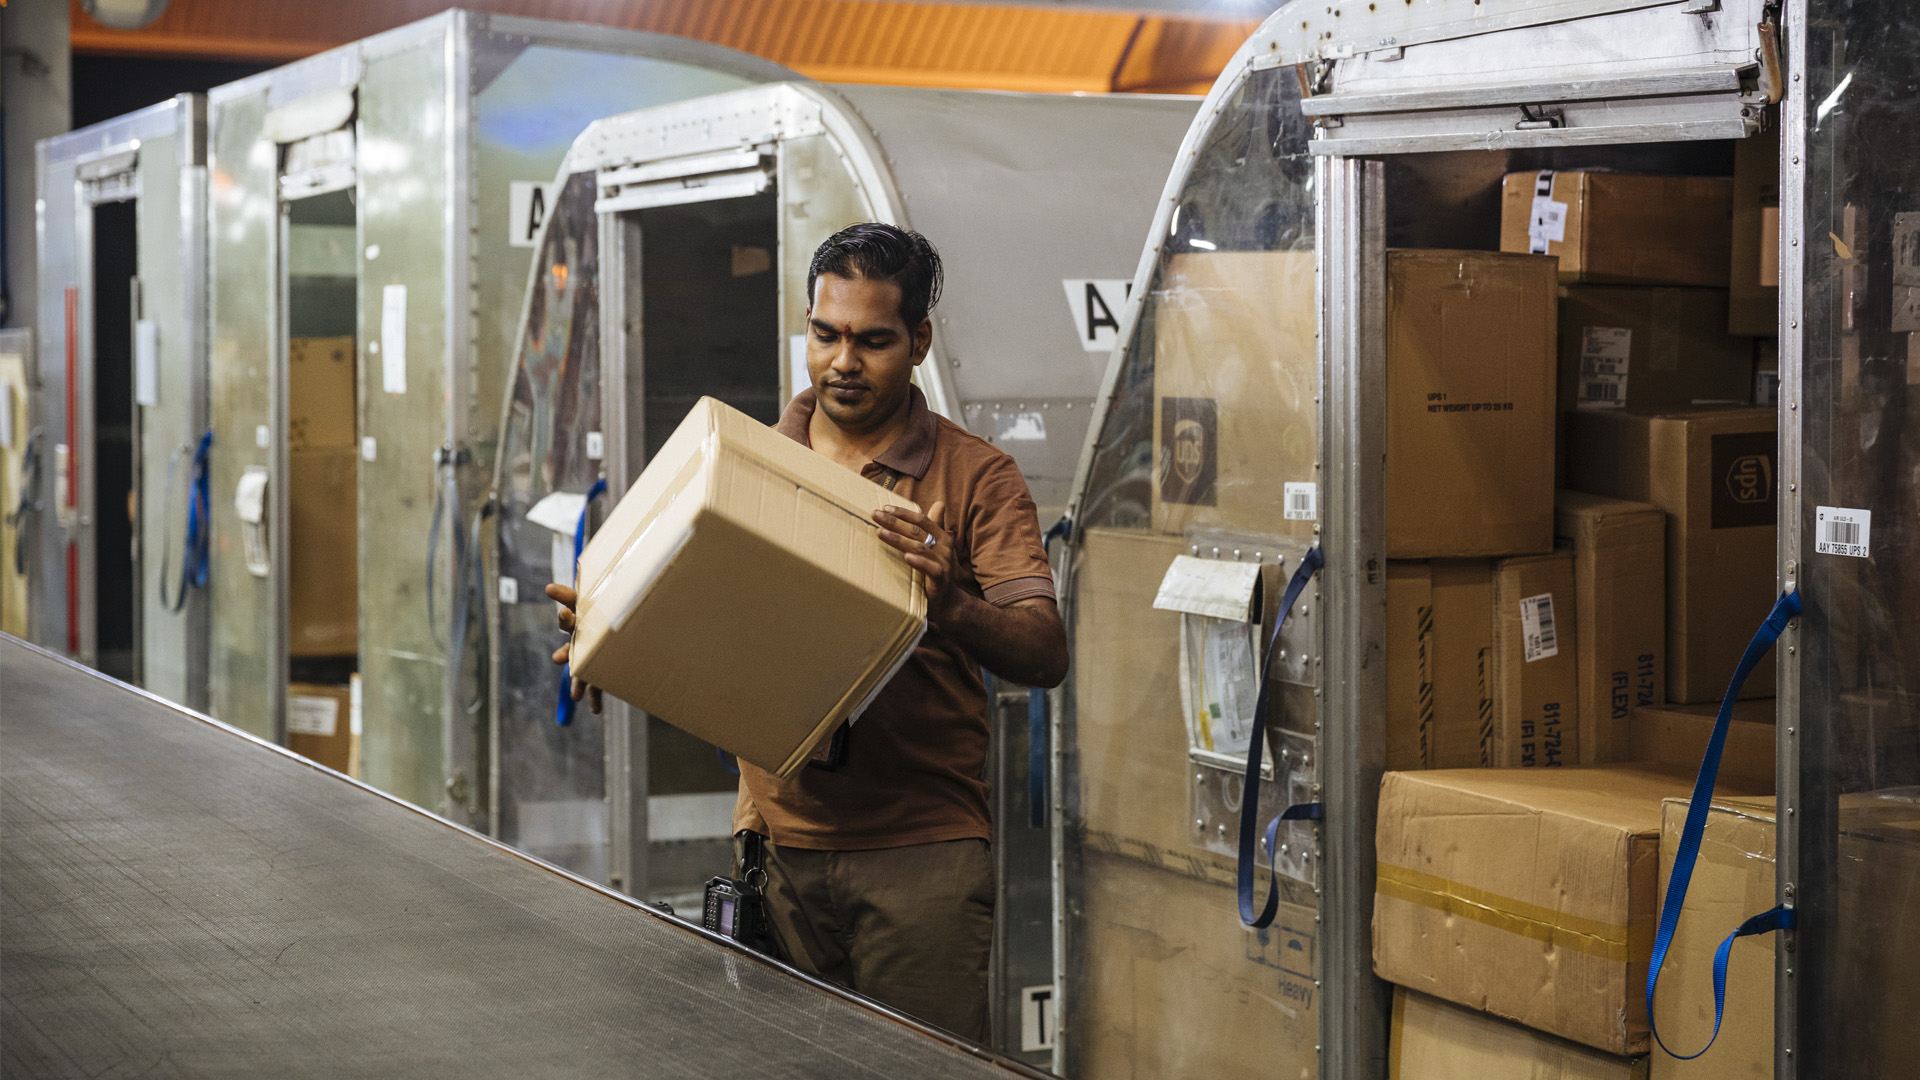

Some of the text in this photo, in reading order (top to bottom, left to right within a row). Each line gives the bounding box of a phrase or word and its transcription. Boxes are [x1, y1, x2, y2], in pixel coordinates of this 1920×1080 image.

[1427, 404, 1441, 412] NET
[1443, 403, 1470, 412] WEIGHT
[1471, 403, 1482, 411] UP
[1483, 403, 1492, 411] TO
[1176, 439, 1201, 473] ups
[1733, 459, 1758, 500] ups
[1818, 542, 1830, 553] AAY
[1849, 545, 1861, 556] UPS
[1862, 546, 1867, 557] 2
[1611, 671, 1629, 720] (FLEX)
[1277, 974, 1313, 1011] Heavy
